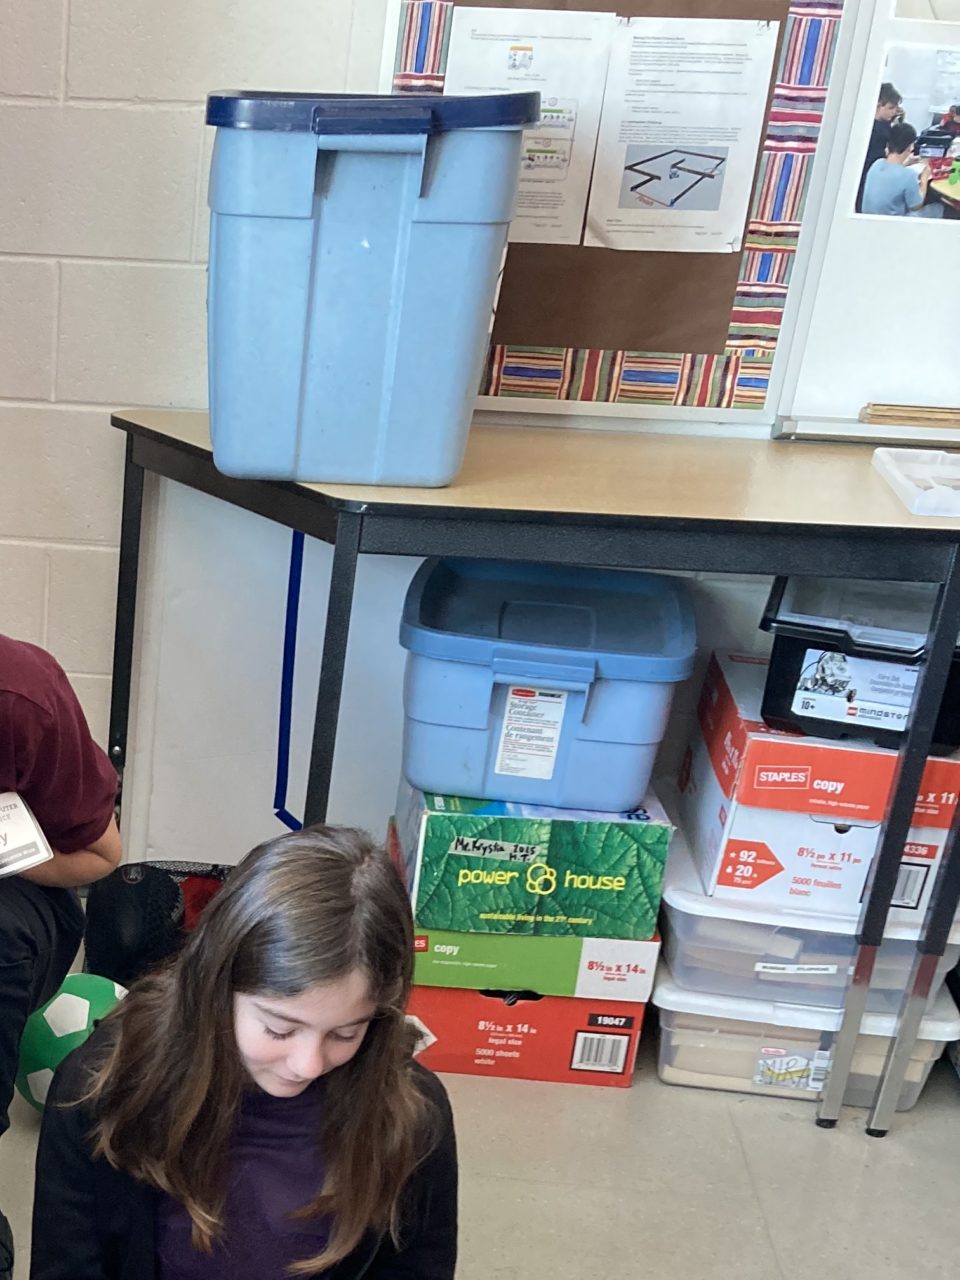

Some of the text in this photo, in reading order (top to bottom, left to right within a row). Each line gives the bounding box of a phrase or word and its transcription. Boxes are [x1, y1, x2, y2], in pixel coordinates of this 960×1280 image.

[510, 701, 537, 711] Storage
[800, 700, 815, 710] 10+
[508, 708, 544, 718] Container
[506, 724, 544, 734] Contenant
[759, 771, 806, 783] STAPLES
[813, 779, 844, 794] copy
[739, 850, 756, 863] 92
[841, 852, 852, 863] 11
[735, 865, 752, 877] 20
[458, 868, 626, 891] power house
[792, 876, 812, 886] 5000
[789, 887, 811, 897] blanc
[434, 944, 460, 956] copy
[626, 964, 639, 973] 14
[597, 1016, 626, 1026] 19047
[517, 1023, 529, 1033] 14
[475, 1048, 495, 1056] 5000
